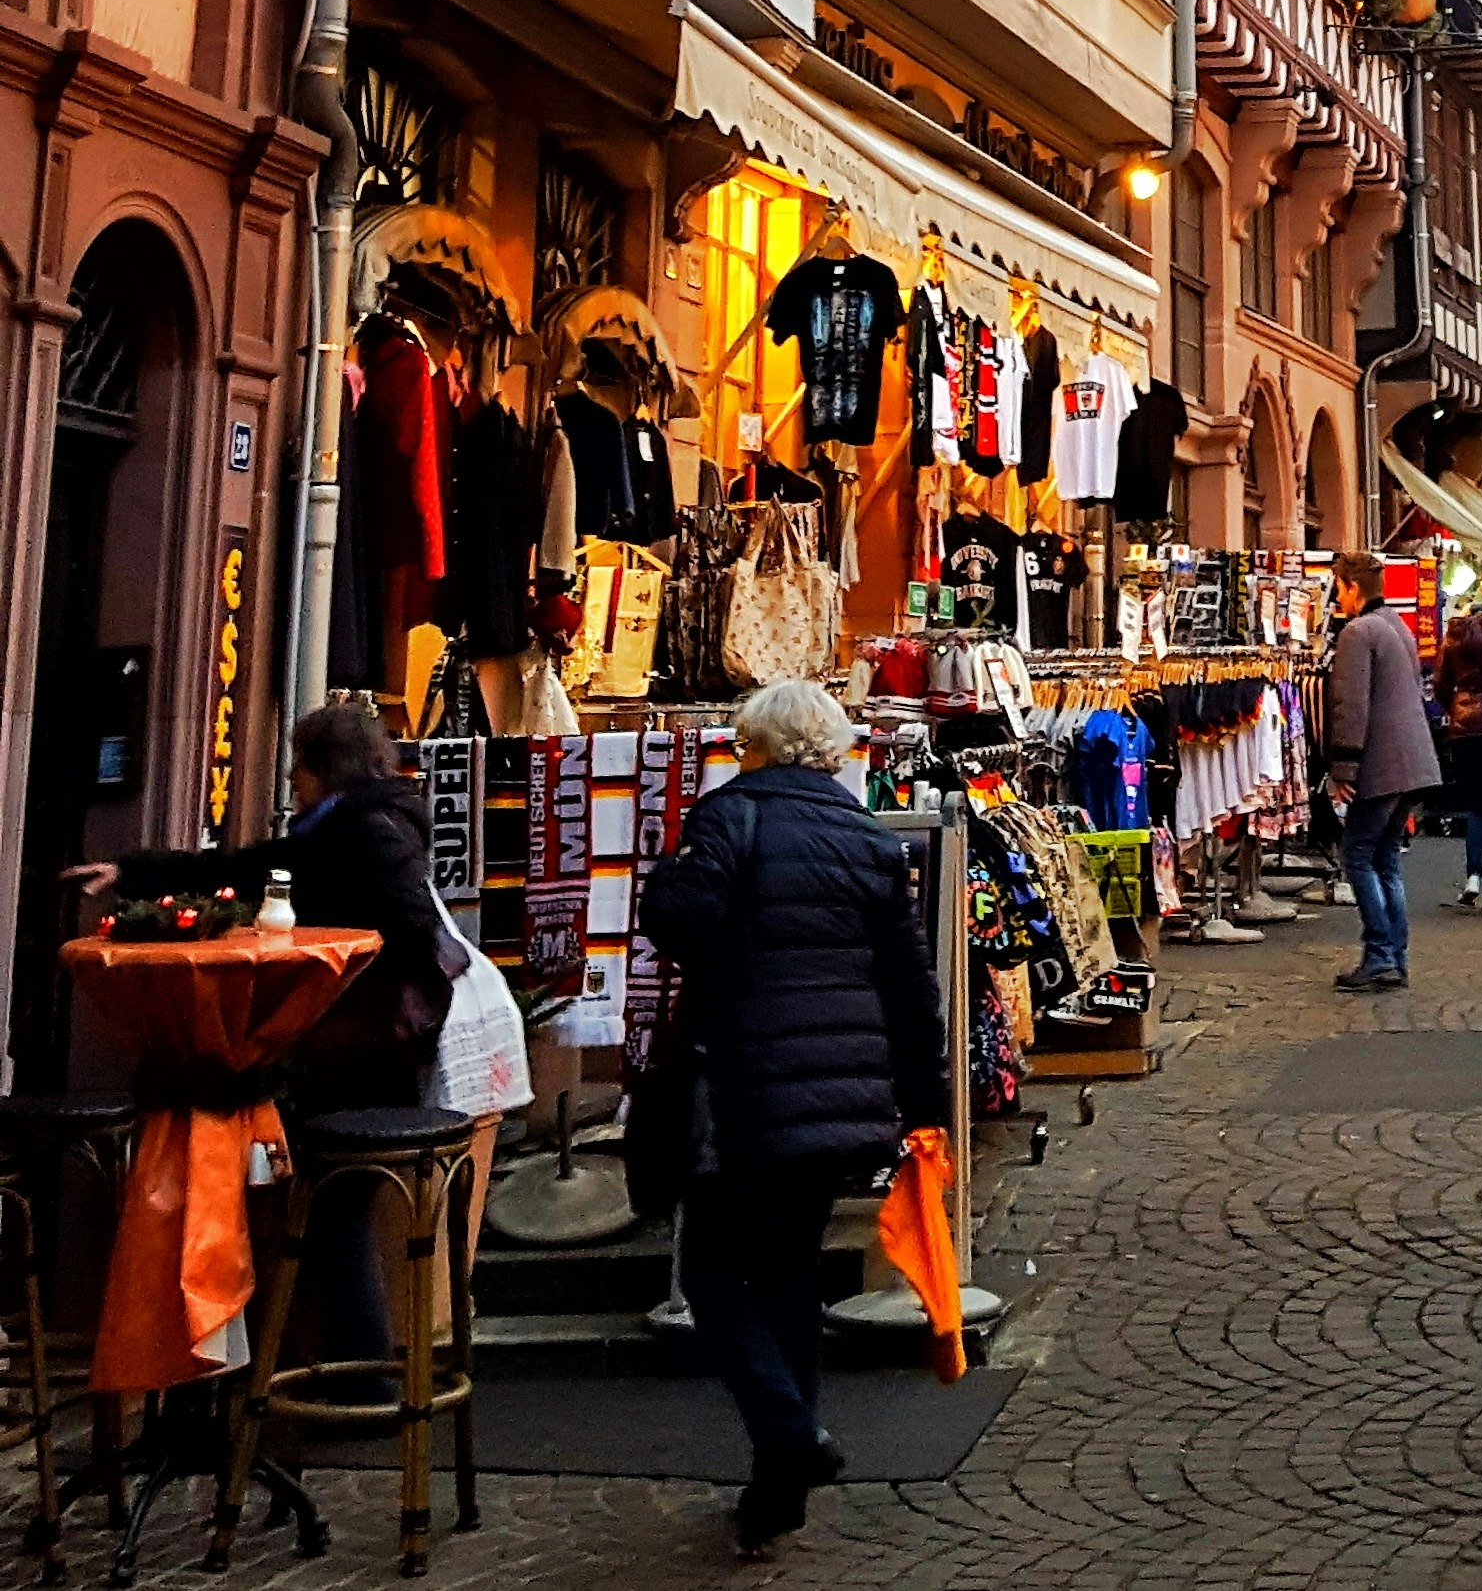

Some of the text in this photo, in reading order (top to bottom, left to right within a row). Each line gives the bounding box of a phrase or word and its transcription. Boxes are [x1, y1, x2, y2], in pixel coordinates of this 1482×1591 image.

[433, 743, 469, 889] SUPER
[529, 752, 547, 877] DEUTSCHER
[553, 735, 588, 873] MÜN
